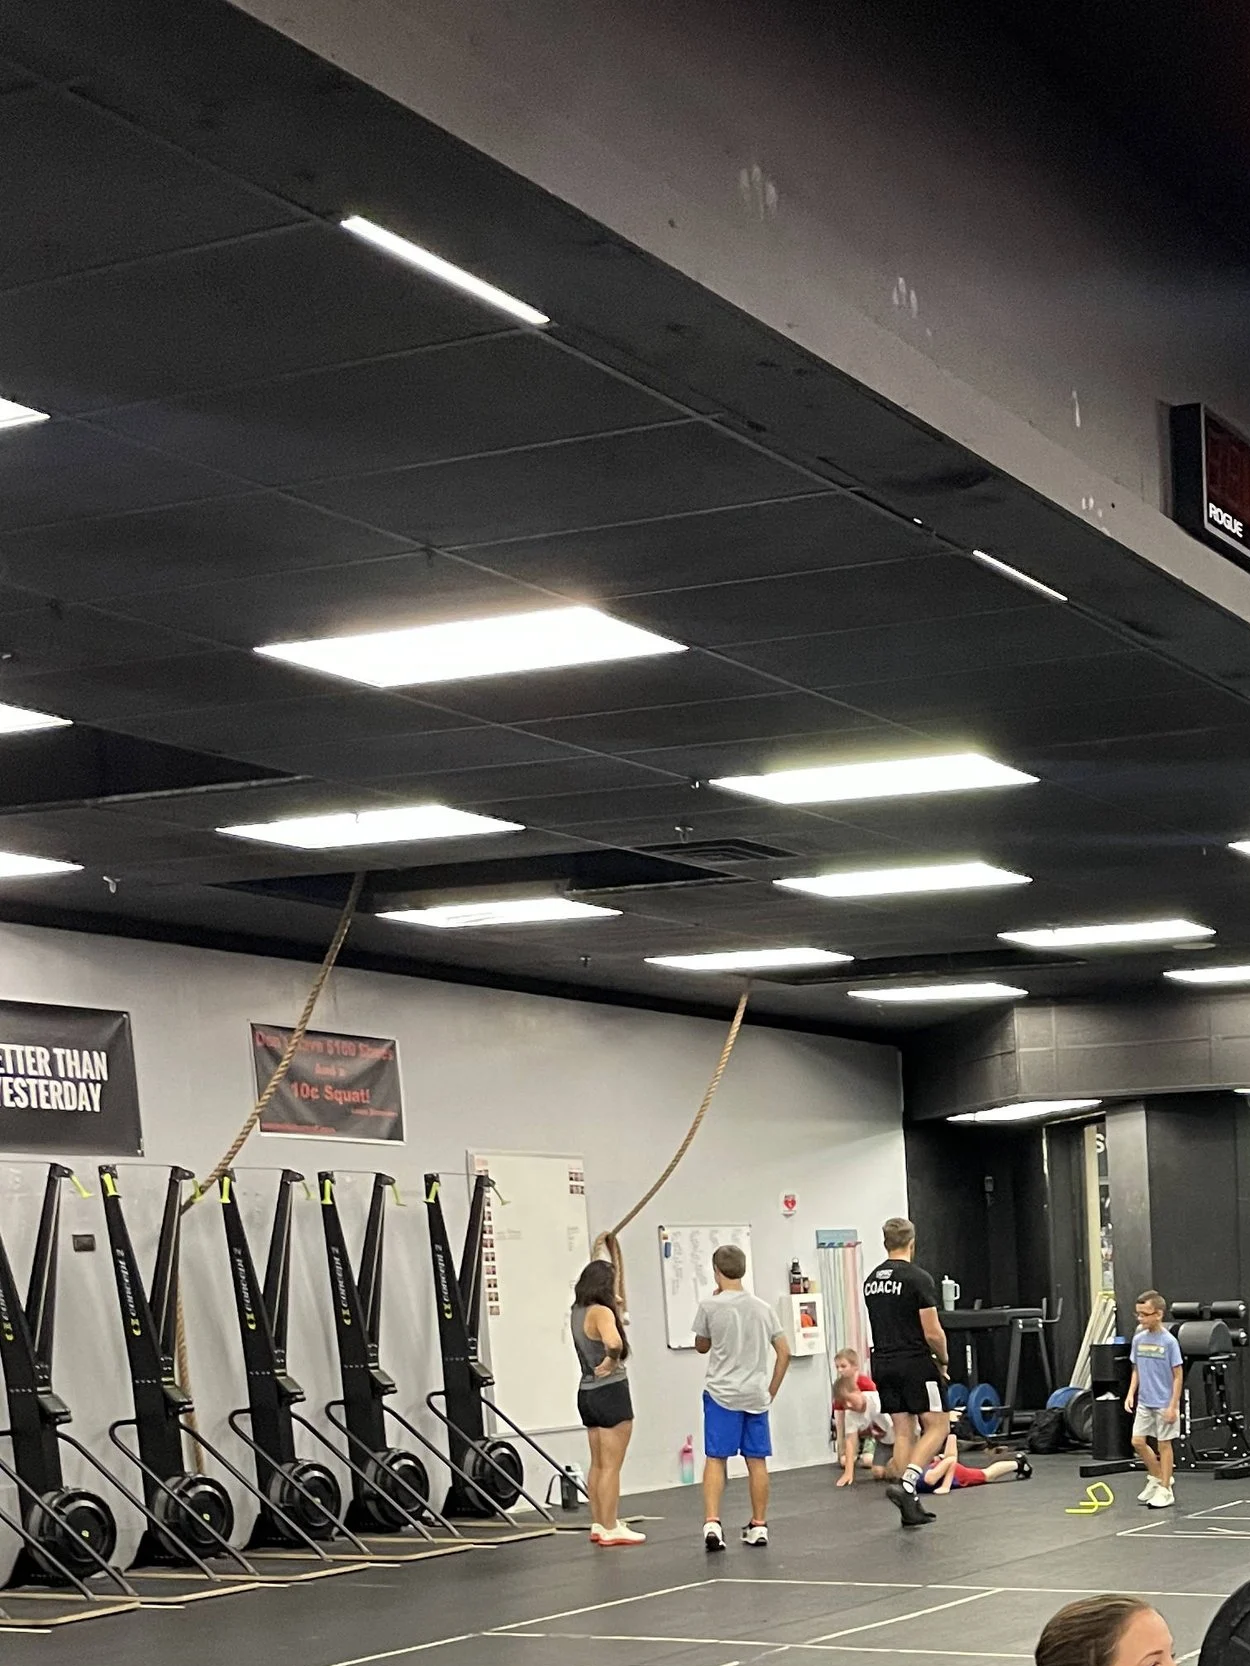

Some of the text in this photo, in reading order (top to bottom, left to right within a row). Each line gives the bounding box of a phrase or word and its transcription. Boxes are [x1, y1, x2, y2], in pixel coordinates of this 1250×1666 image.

[1208, 502, 1244, 538] ROGUE
[53, 1047, 109, 1081] THAN
[0, 1075, 103, 1113] ESTERDAY
[324, 1084, 371, 1105] Squat!
[864, 1279, 903, 1297] COACH
